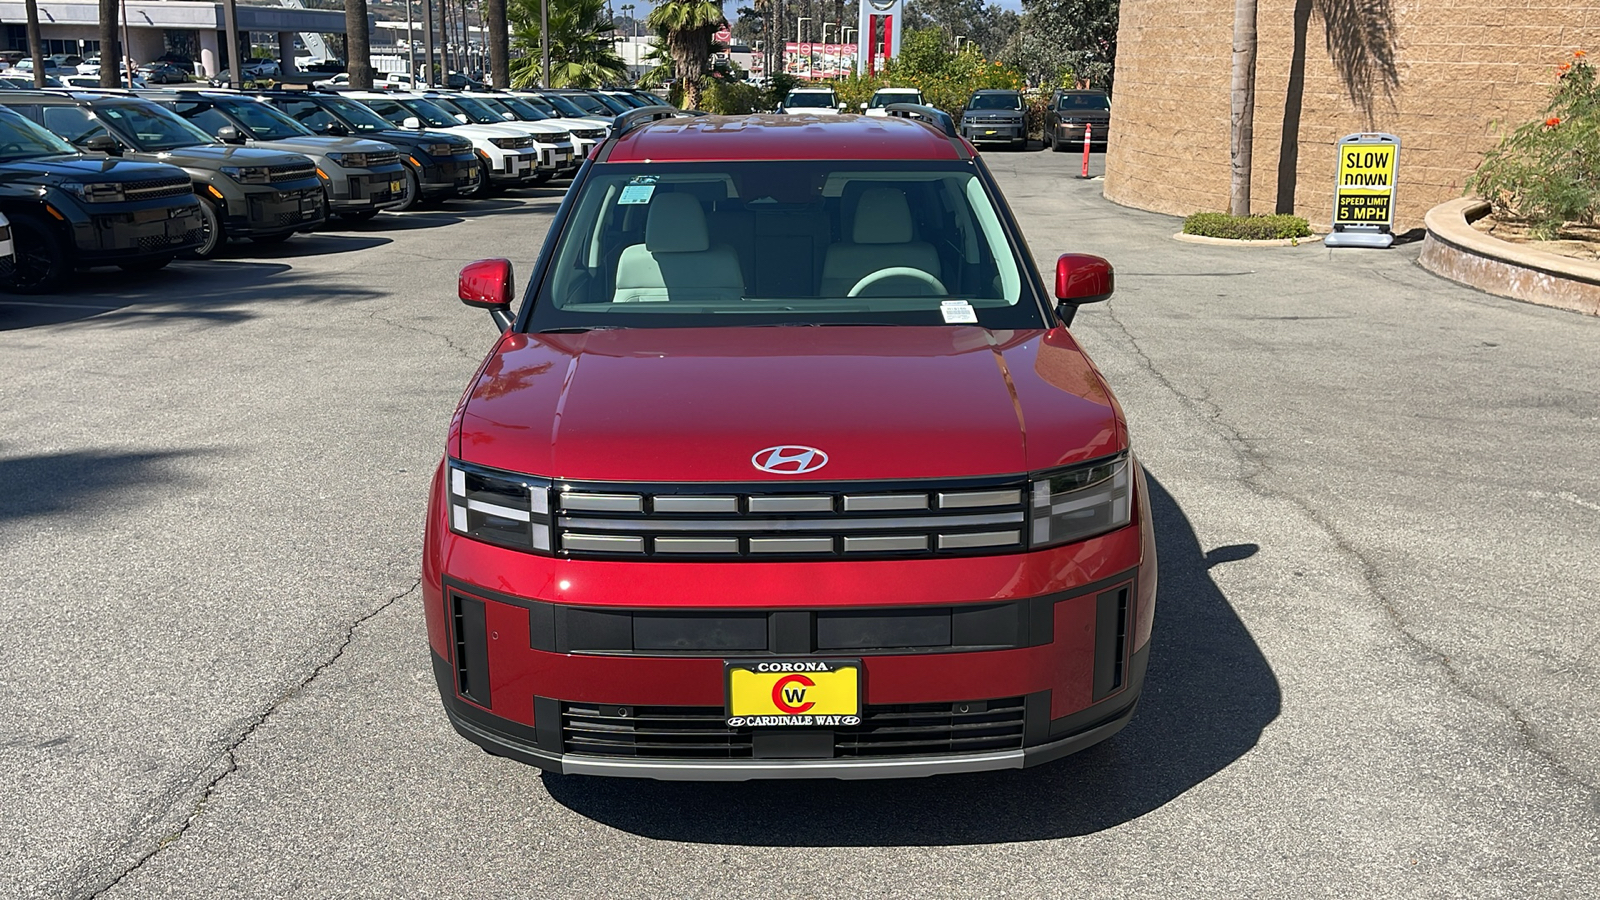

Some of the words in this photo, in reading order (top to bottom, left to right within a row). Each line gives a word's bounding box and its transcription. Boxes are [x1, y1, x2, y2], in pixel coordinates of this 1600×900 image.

[1346, 153, 1389, 168] SLOW
[1340, 208, 1349, 219] 5
[1354, 208, 1386, 219] MPH
[758, 663, 828, 671] CORONA
[746, 716, 812, 726] CARDINALE
[816, 716, 841, 725] WAY
